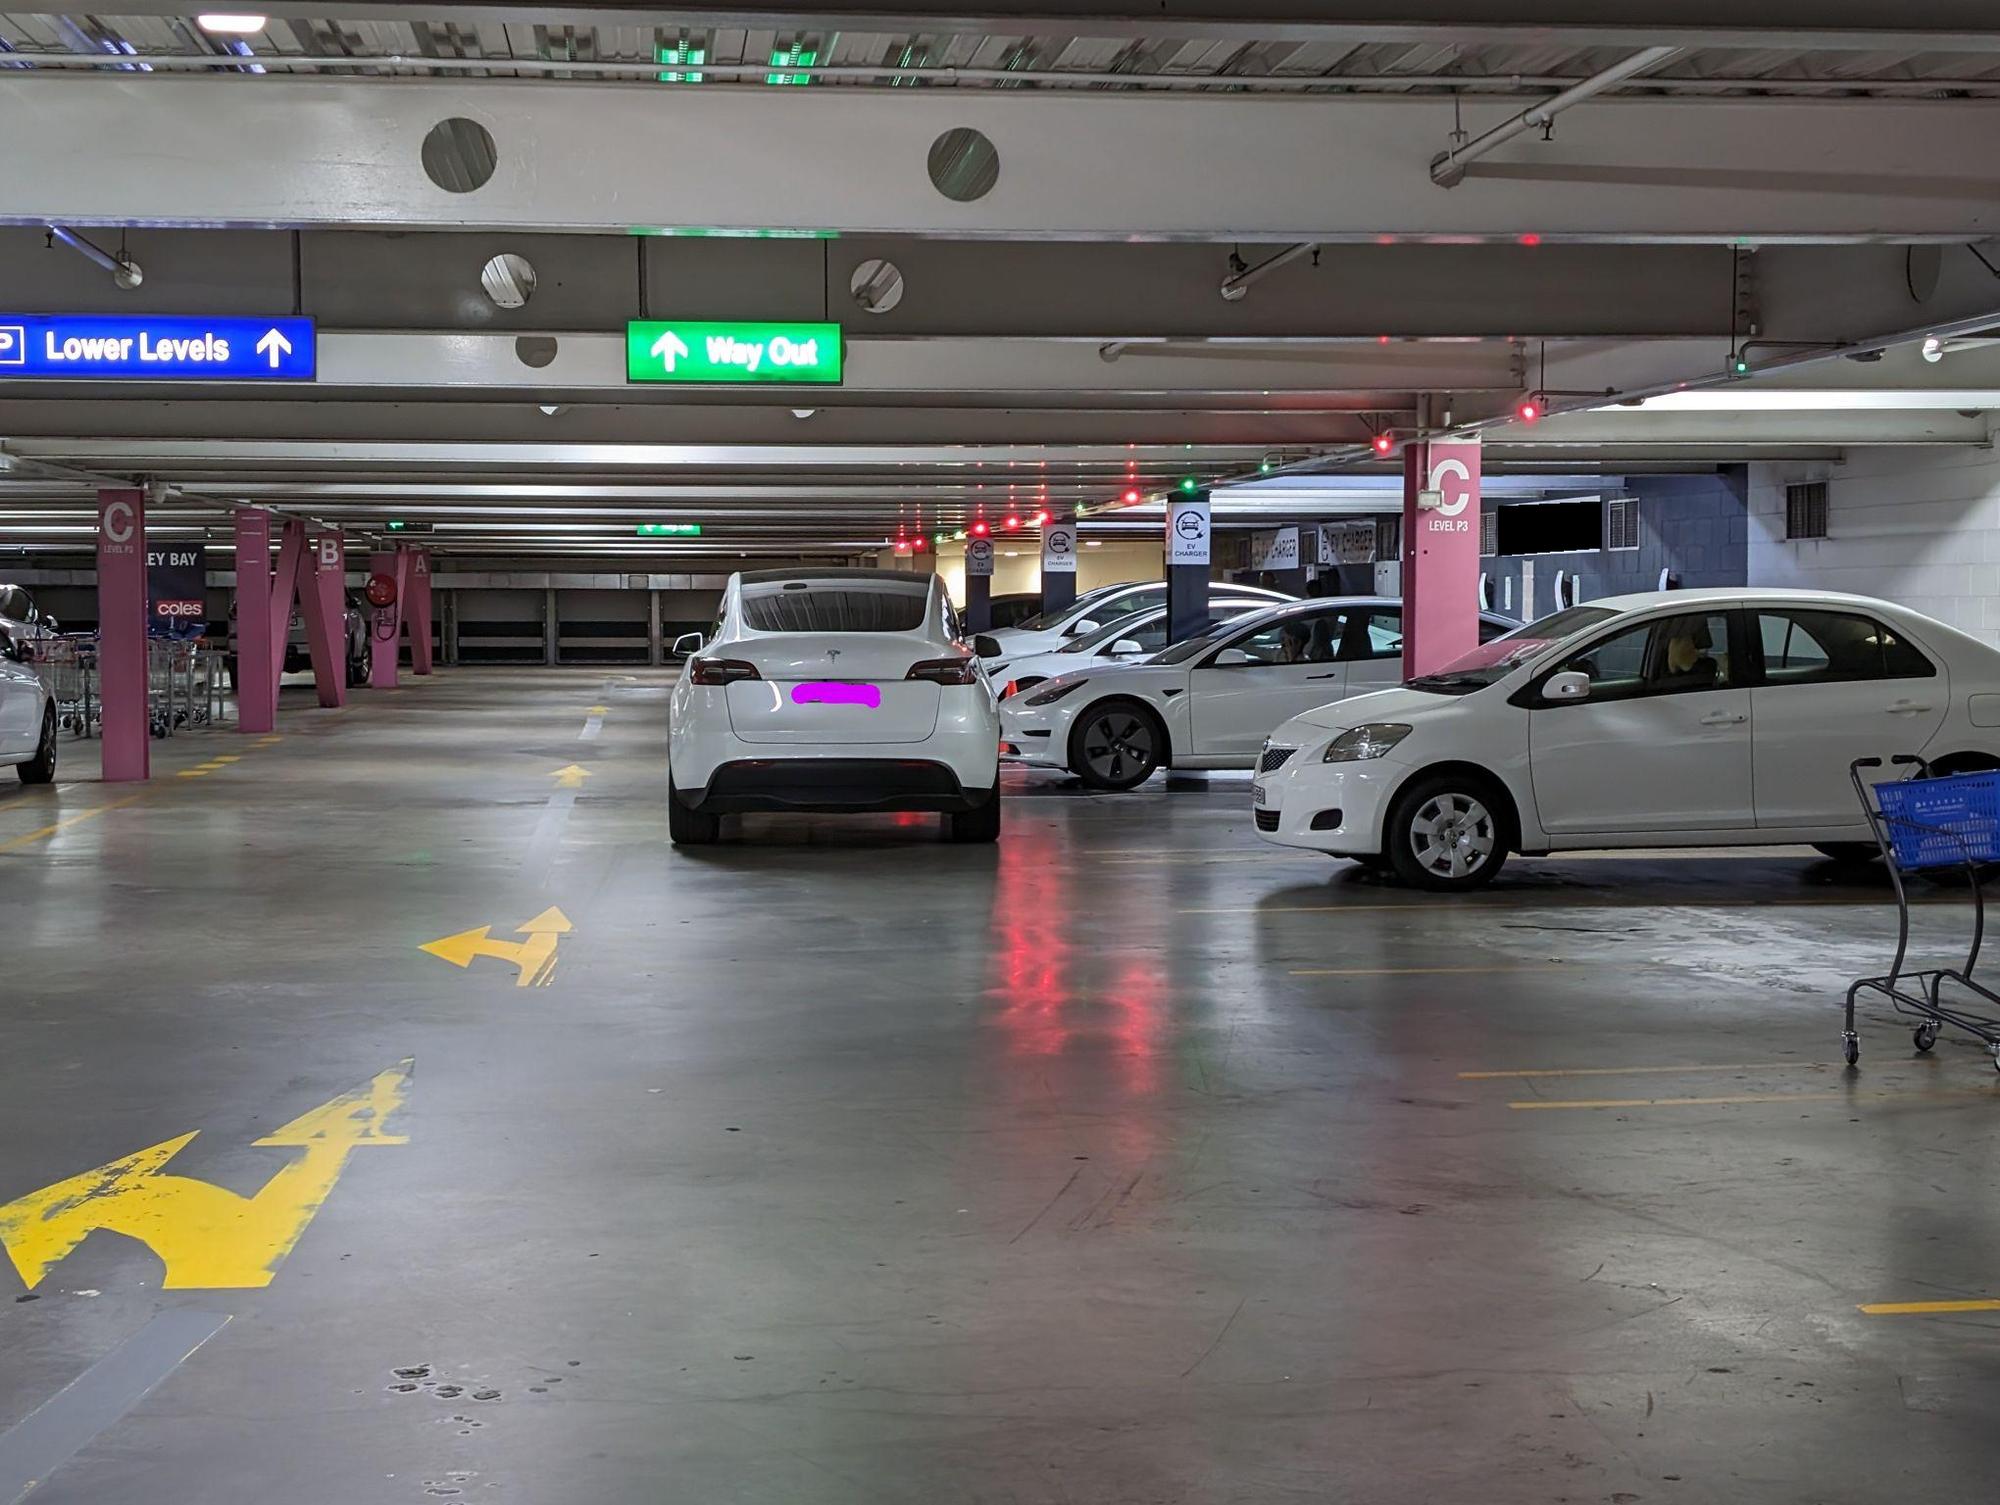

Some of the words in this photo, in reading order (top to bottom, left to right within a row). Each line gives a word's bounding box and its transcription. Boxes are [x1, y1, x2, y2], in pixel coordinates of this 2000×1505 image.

[46, 331, 132, 360] Lower
[139, 332, 230, 362] Levels
[706, 336, 763, 371] Way
[768, 336, 818, 366] Out
[1430, 459, 1469, 516] C
[104, 501, 134, 543] C
[1429, 520, 1455, 532] LEVEL
[1457, 520, 1469, 532] P3
[145, 553, 165, 566] EY
[170, 553, 197, 566] BAY
[321, 539, 339, 564] B
[415, 554, 427, 573] A
[157, 601, 202, 616] coles
